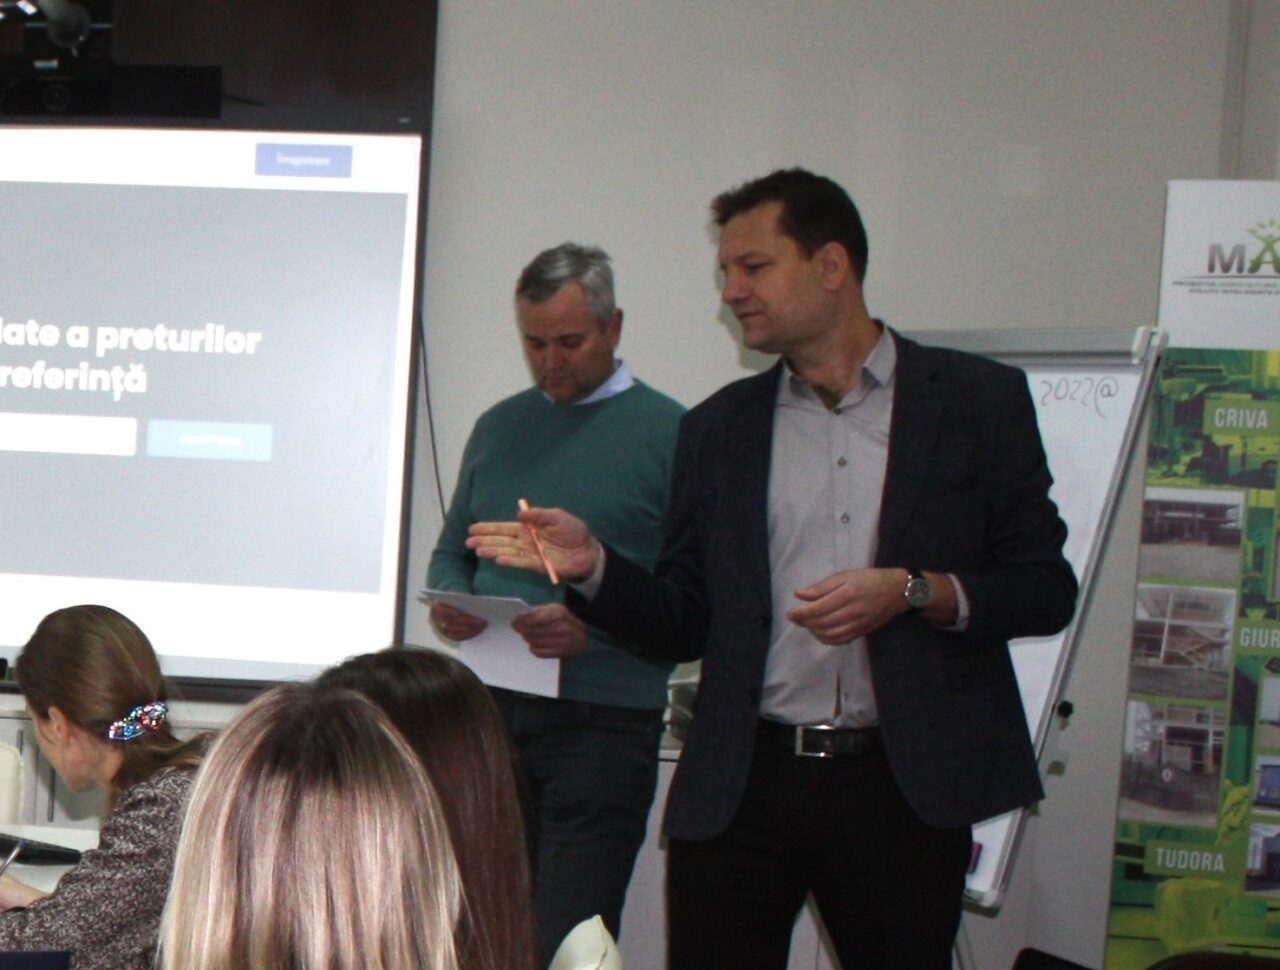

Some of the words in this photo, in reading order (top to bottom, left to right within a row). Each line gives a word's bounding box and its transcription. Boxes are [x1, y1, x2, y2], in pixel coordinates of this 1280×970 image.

[66, 325, 89, 348] a
[96, 323, 261, 357] preturilor
[1214, 407, 1269, 430] CRIVA
[1155, 847, 1225, 873] TUDORA
